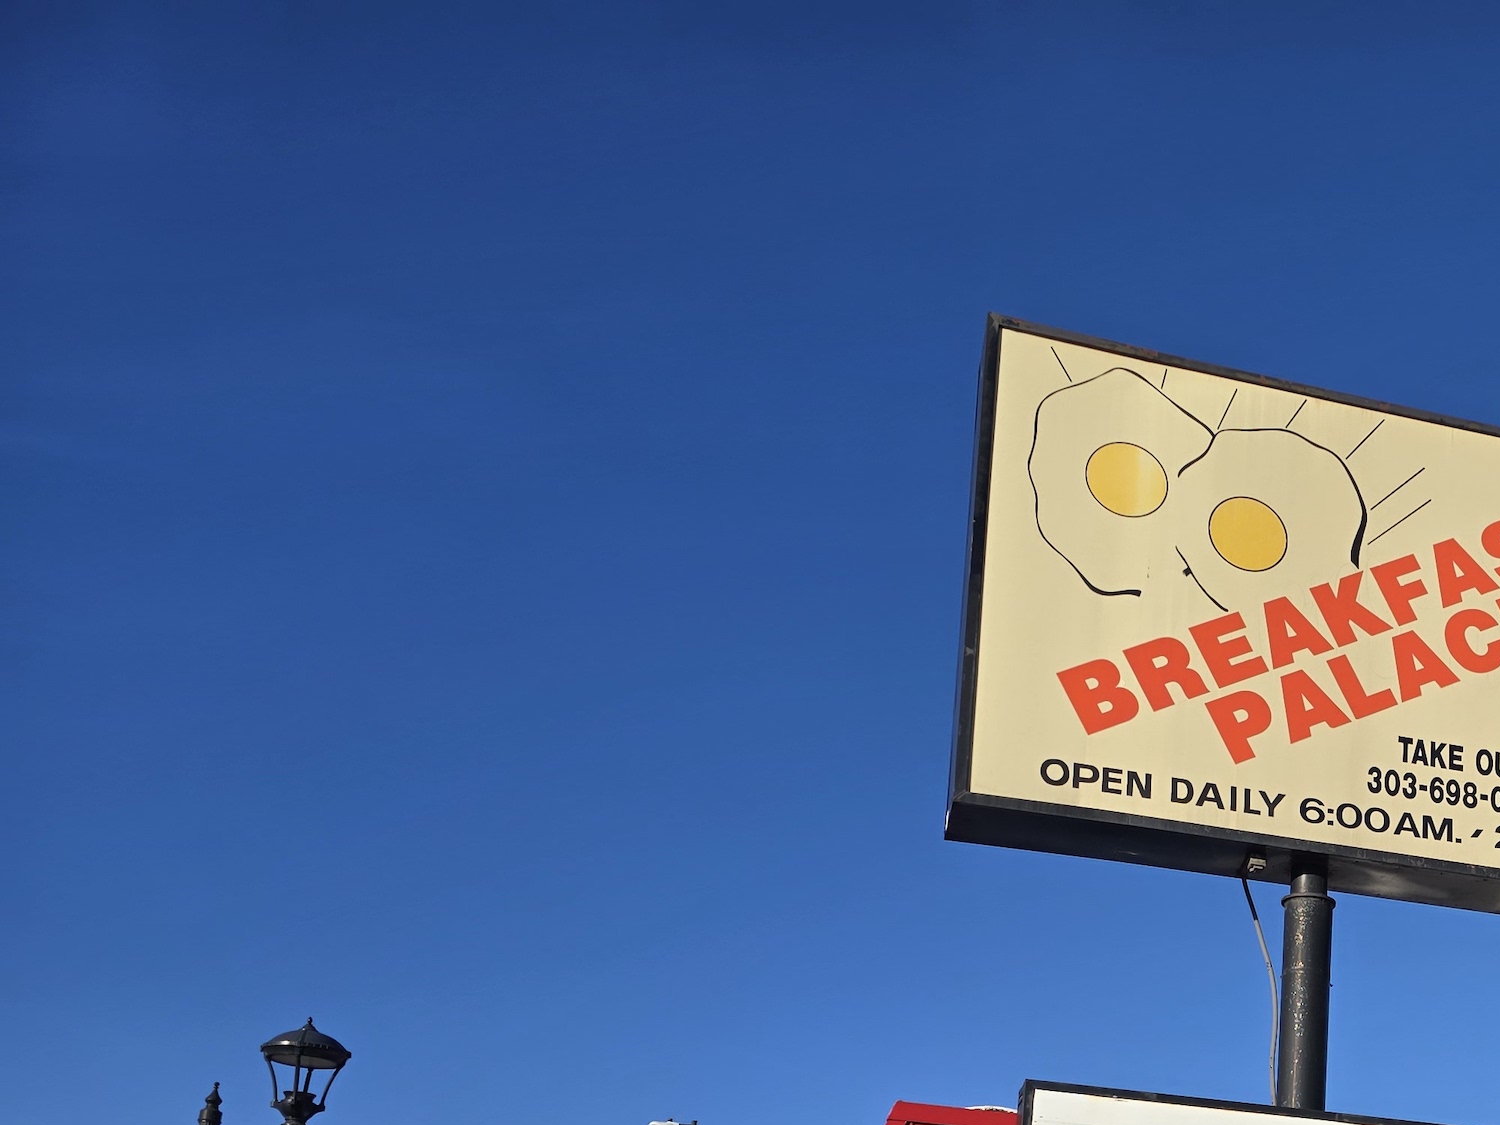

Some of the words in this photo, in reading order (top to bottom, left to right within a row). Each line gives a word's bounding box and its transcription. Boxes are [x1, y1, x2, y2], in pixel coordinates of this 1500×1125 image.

[1398, 736, 1464, 772] TAKE
[1040, 758, 1153, 799] OPEN
[1171, 776, 1286, 818] DAILY
